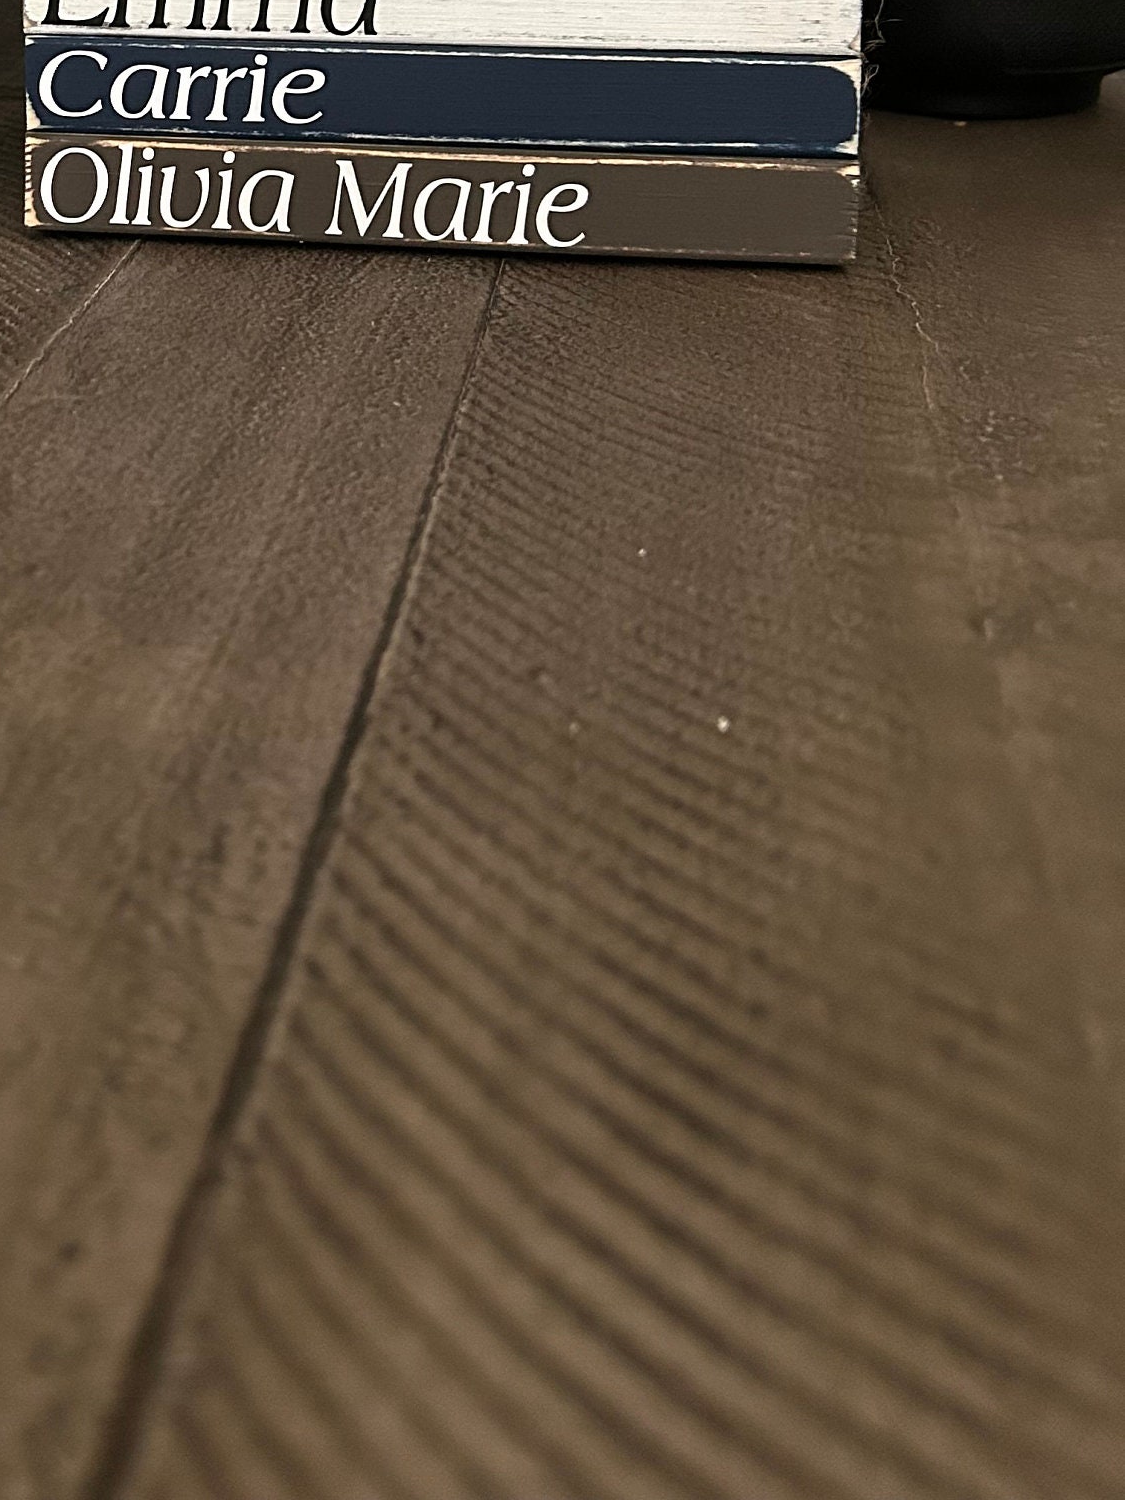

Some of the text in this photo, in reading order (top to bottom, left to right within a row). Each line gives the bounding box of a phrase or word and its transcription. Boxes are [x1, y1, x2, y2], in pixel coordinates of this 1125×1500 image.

[38, 50, 326, 124] Carrie
[39, 145, 590, 247] Olivia Marie
